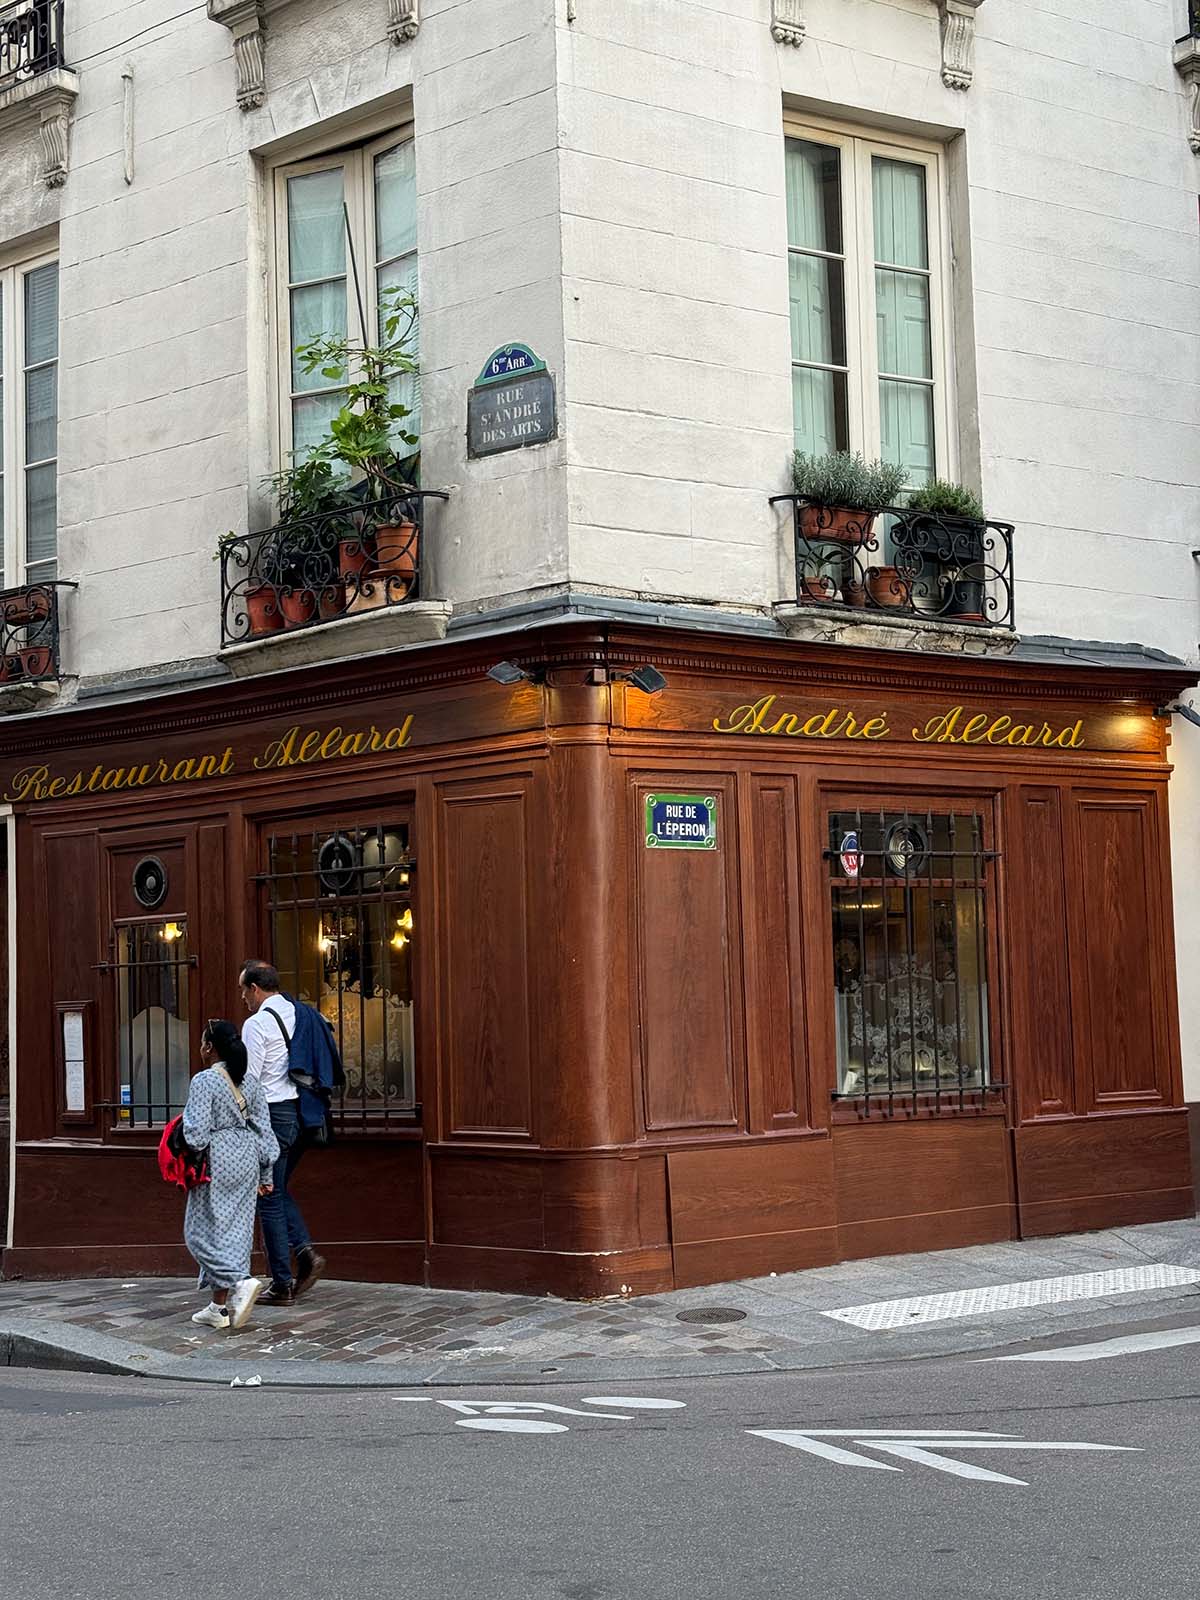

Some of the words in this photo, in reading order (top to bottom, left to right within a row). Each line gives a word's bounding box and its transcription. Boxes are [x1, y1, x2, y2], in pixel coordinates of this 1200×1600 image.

[496, 387, 525, 405] RUE
[494, 397, 541, 424] ANDRÉ
[712, 694, 891, 739] André
[911, 706, 1085, 749] Allard
[3, 746, 235, 801] Restaurant
[252, 713, 414, 770] Allard
[666, 804, 684, 818] RUE
[685, 805, 697, 819] DE
[657, 820, 706, 837] L'ÉPERON
